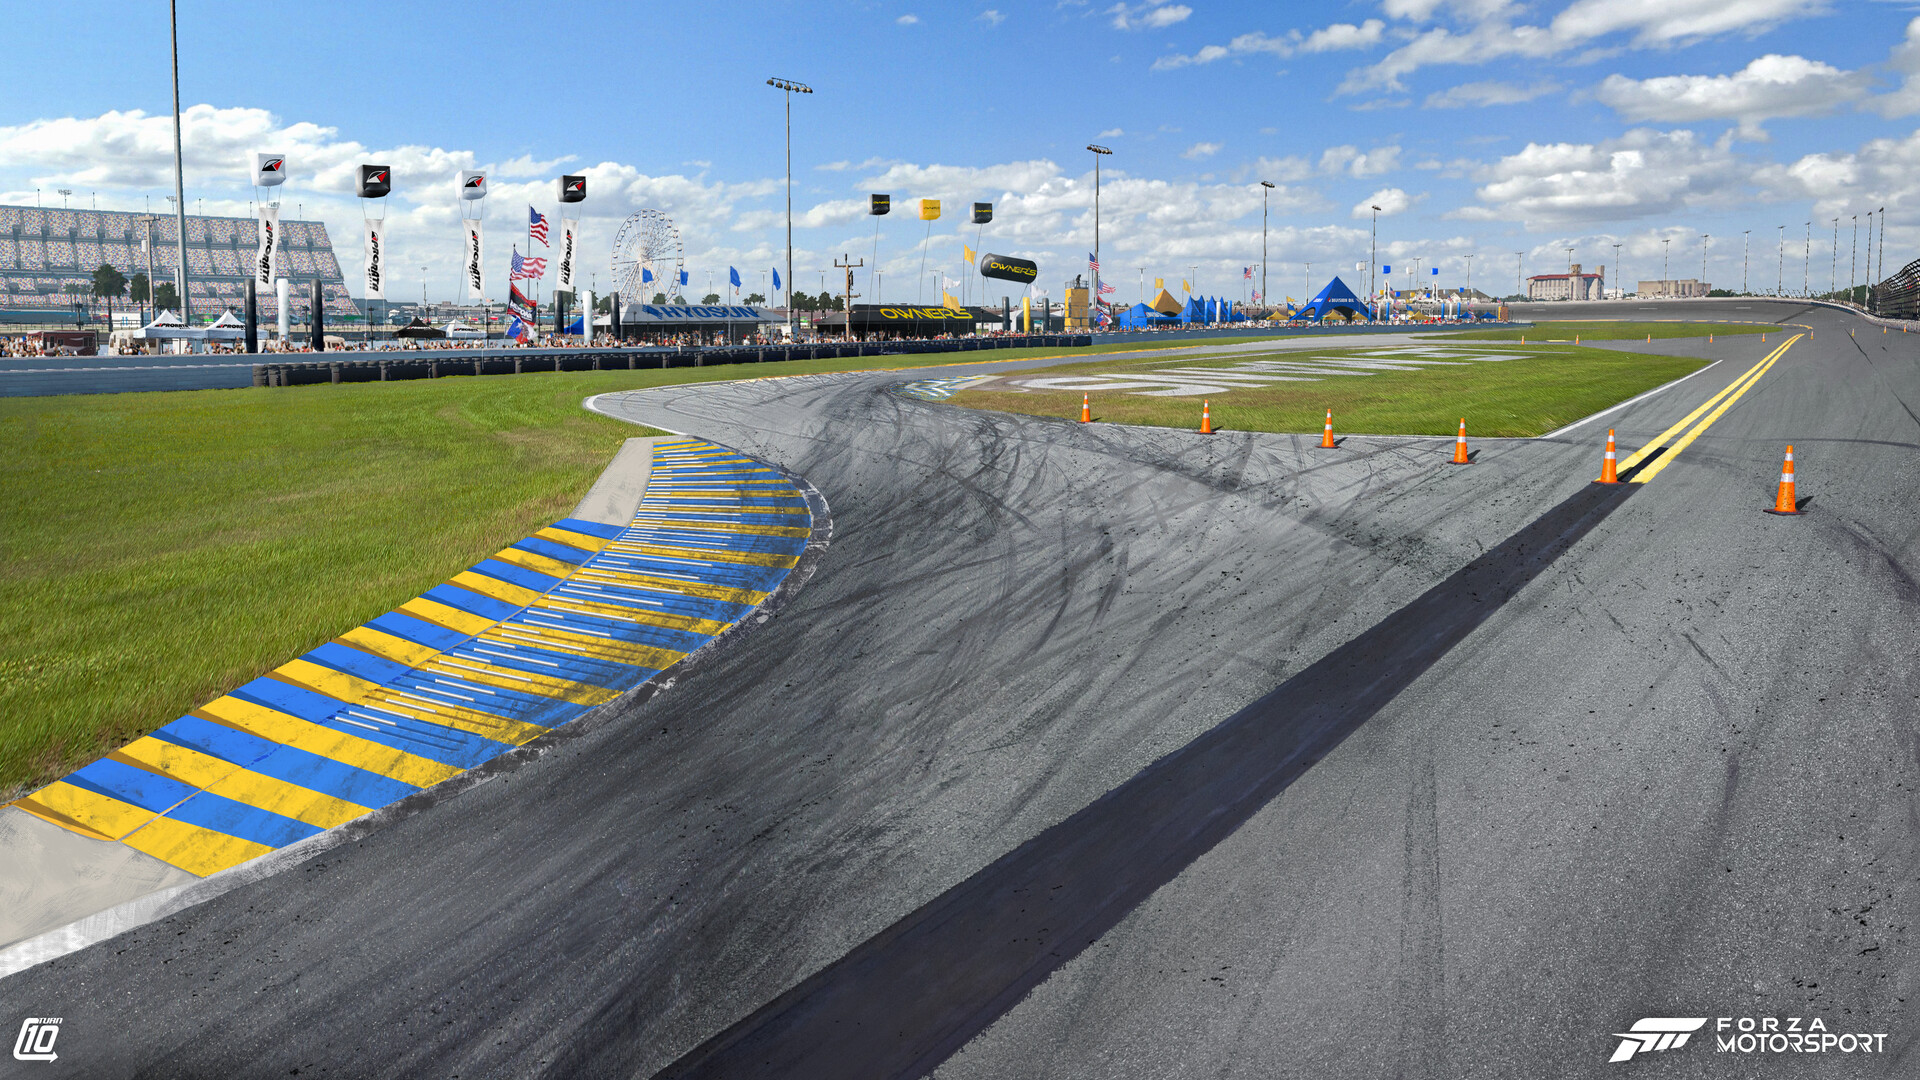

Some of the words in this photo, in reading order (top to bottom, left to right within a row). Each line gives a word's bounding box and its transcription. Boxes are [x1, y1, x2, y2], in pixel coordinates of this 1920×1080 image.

[262, 228, 272, 284] PRORATA
[371, 240, 379, 291] PRORATA
[471, 238, 481, 290] PRORATA
[563, 237, 572, 285] PRORATA
[990, 261, 1037, 277] OWNER'S
[879, 308, 973, 319] OWNERS
